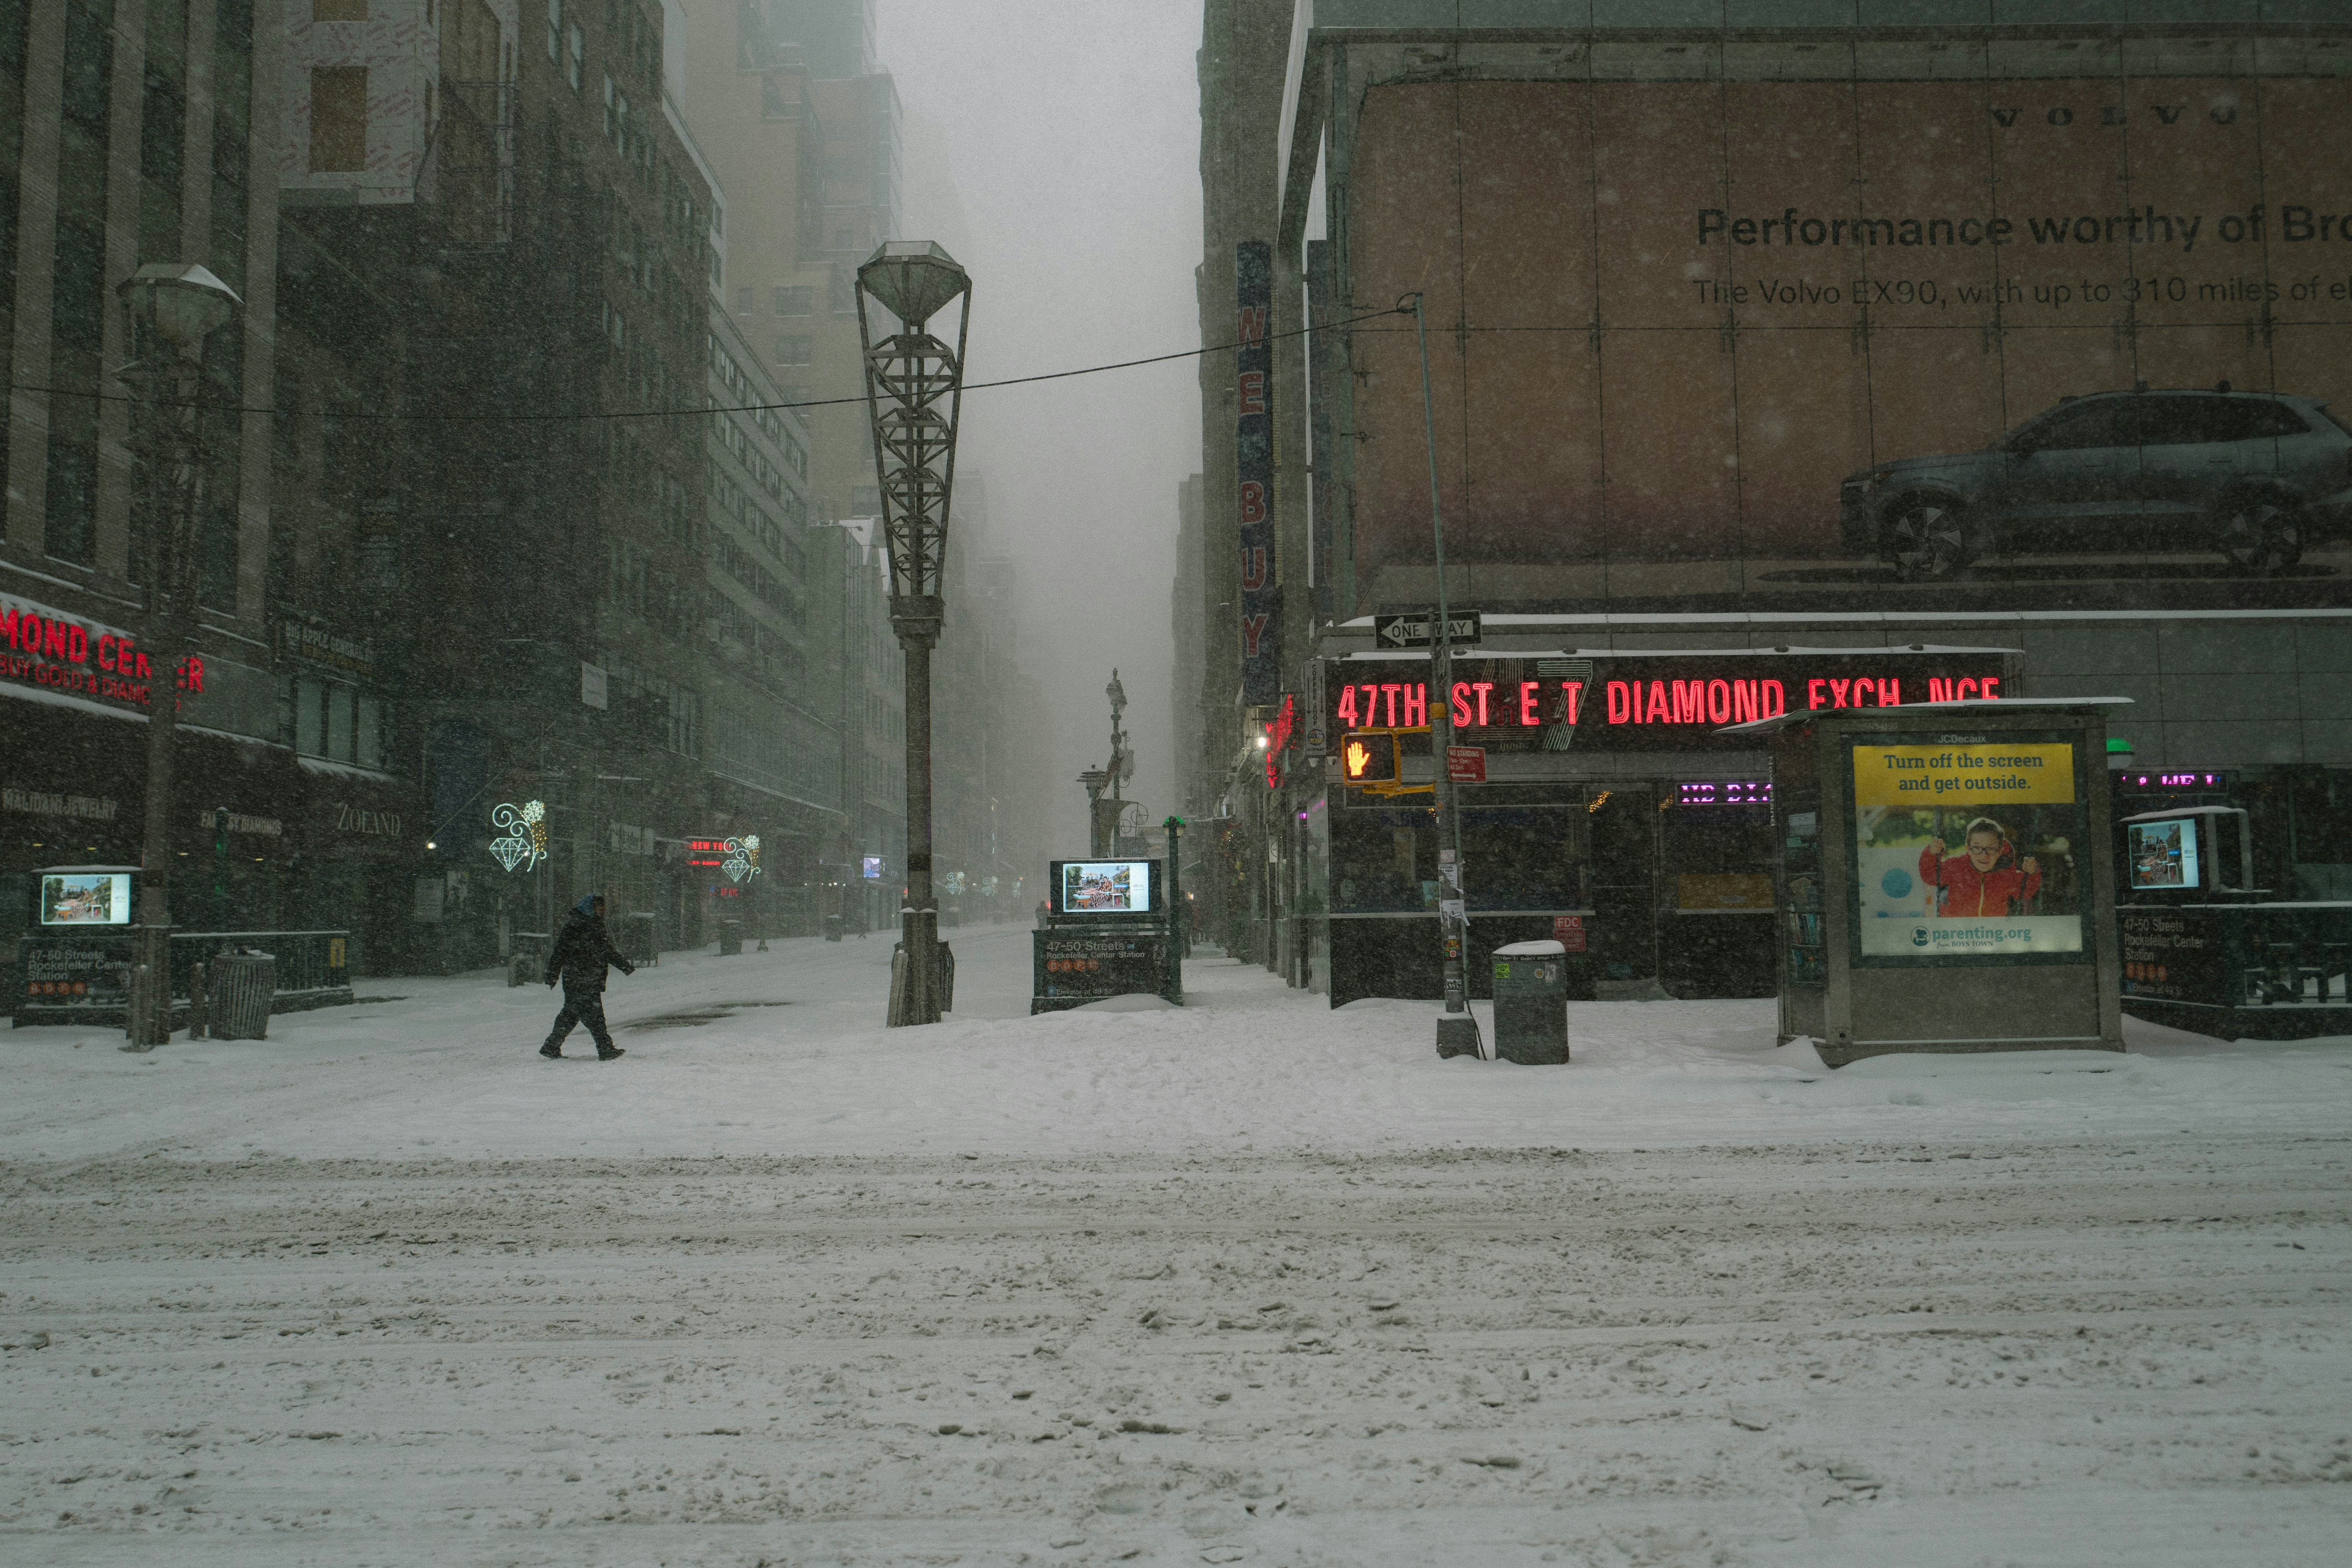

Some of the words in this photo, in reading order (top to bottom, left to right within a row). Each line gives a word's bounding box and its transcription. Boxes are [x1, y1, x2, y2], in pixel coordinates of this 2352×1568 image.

[1987, 106, 2237, 127] VOLVO
[1698, 208, 2013, 246] Performance
[2029, 205, 2201, 252] worthy
[2219, 204, 2265, 243] of
[1693, 279, 1748, 304] The
[1759, 279, 1841, 304] Volvo
[1853, 280, 1946, 310] EX90,
[1958, 279, 2023, 304] with
[2034, 282, 2071, 309] up
[2081, 279, 2111, 301] to
[2122, 277, 2186, 301] 310
[2199, 277, 2279, 302] miles
[2291, 275, 2320, 301] of
[1238, 306, 1265, 415] WE
[1240, 481, 1269, 658] BUY
[1392, 624, 1421, 638] ONE
[35, 662, 83, 690] GOLD
[87, 673, 97, 693] &
[1338, 683, 1426, 727] 47TH
[1607, 679, 1784, 724] DIAMOND
[1938, 734, 1986, 744] JCDecaux
[1884, 754, 1926, 769] Turn
[1929, 753, 1953, 768] off
[1956, 753, 1983, 768] the
[1988, 755, 2043, 768] screen
[1899, 775, 1929, 791] and
[1934, 777, 1959, 794] get
[1964, 774, 2031, 790] outside.
[692, 841, 710, 850] NEW
[1557, 917, 1578, 927] FDC
[2123, 918, 2149, 931] 47-50
[2152, 918, 2184, 932] Streets
[1932, 926, 2032, 942] parenting.org
[2124, 933, 2171, 948] Rockefeller
[2173, 935, 2204, 949] Center
[64, 949, 105, 960] Streets
[1046, 941, 1081, 952] 47-50
[1085, 941, 1125, 951] Streets
[2125, 947, 2154, 962] Station
[28, 960, 93, 971] Rockefeller
[28, 970, 69, 981] Station
